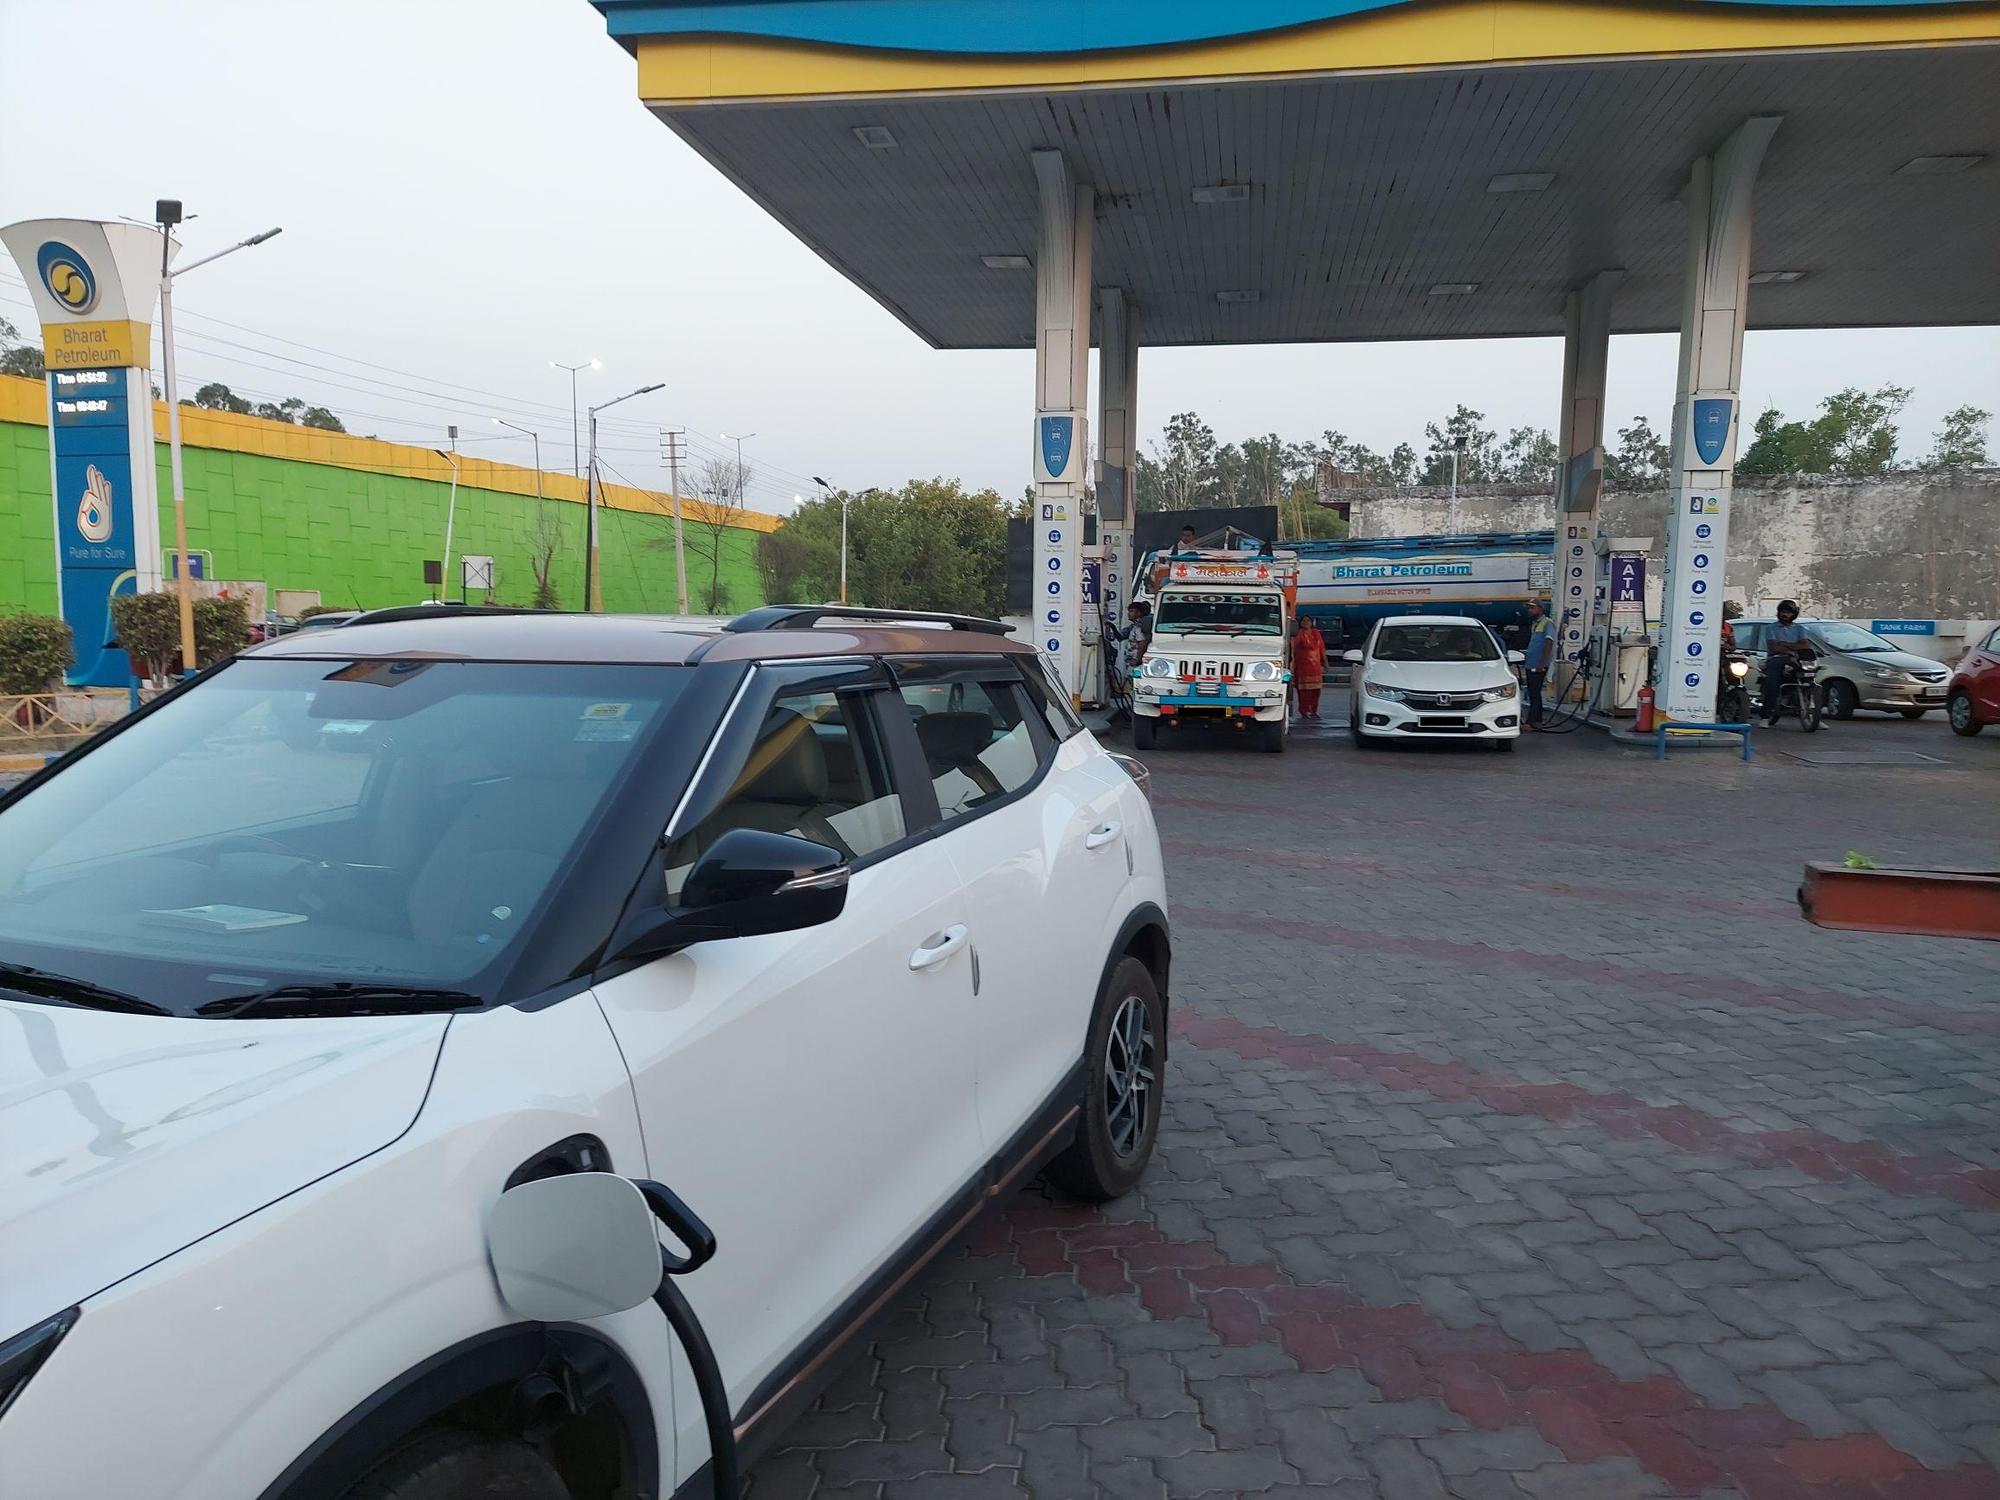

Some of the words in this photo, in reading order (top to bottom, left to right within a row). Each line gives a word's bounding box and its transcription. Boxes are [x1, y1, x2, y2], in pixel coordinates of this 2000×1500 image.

[63, 328, 108, 344] Bharat
[55, 347, 121, 363] Petroleum
[69, 546, 90, 559] Pure
[90, 546, 101, 558] for
[104, 546, 126, 560] Sure
[1336, 566, 1386, 577] Bharat
[1391, 564, 1470, 576] Petroleum
[1621, 563, 1635, 601] ATM
